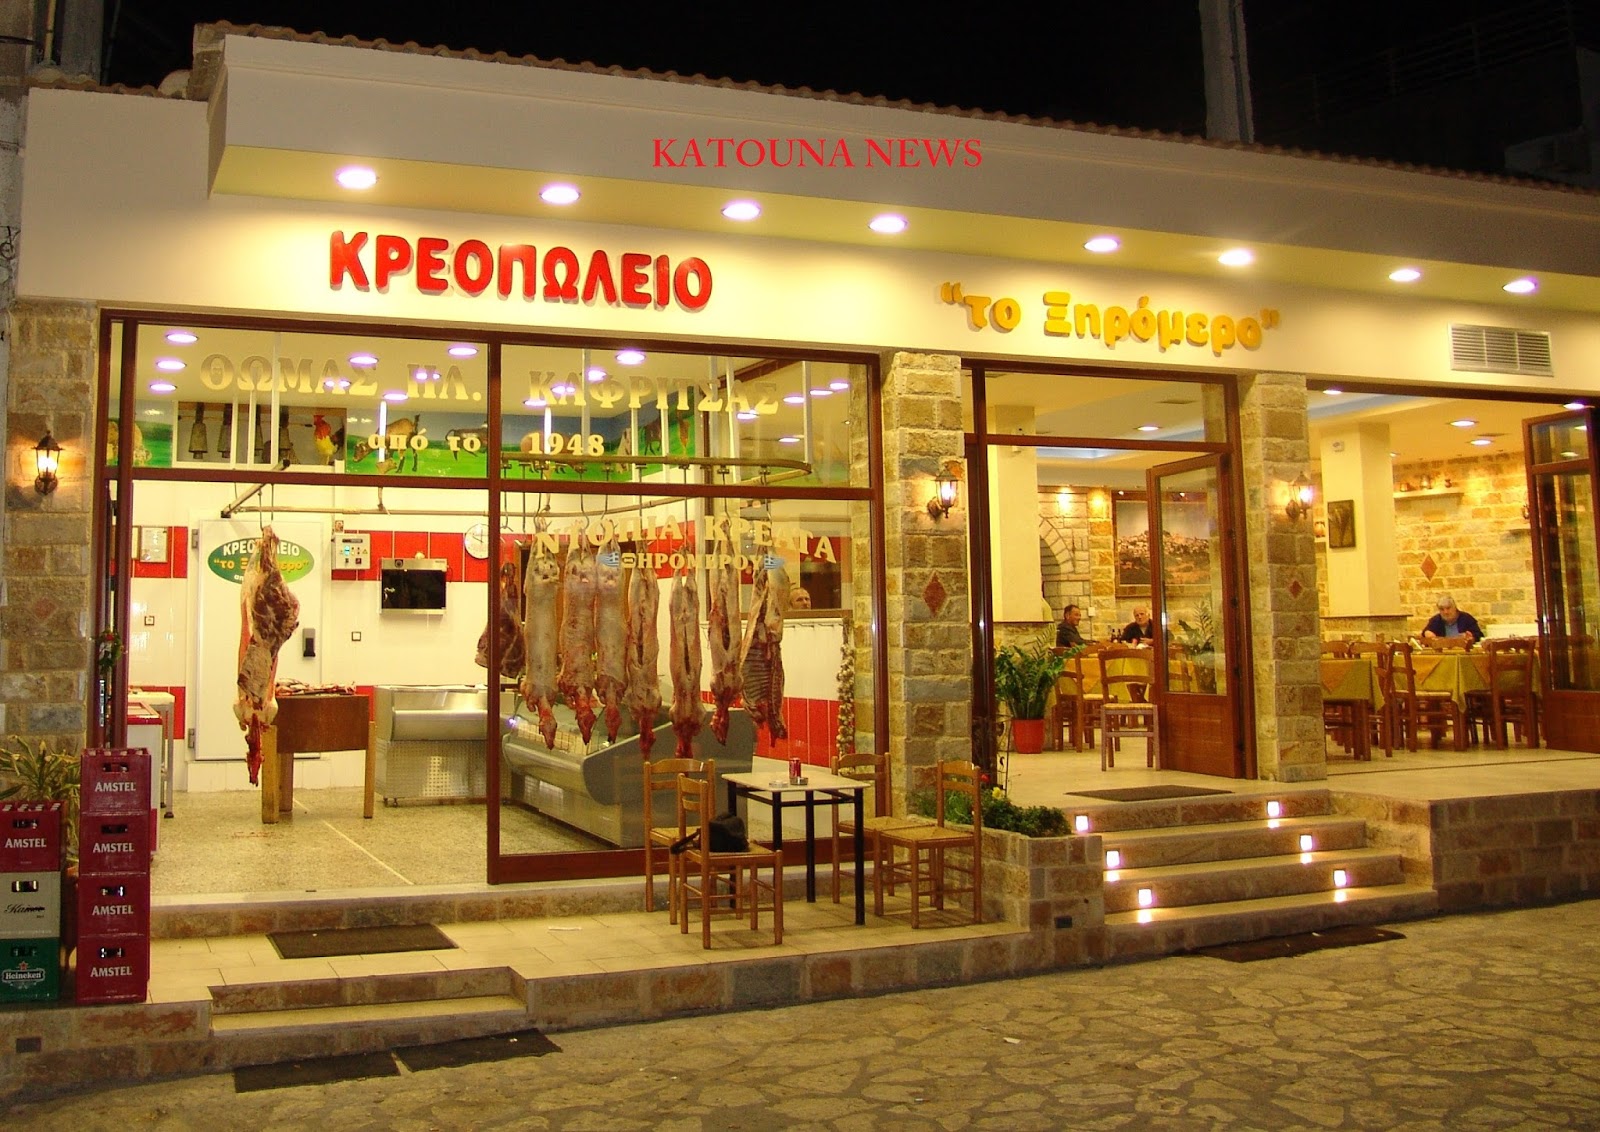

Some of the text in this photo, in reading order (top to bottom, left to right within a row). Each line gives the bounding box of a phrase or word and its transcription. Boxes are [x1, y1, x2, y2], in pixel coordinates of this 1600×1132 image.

[329, 230, 713, 311] ΚΡΕΟΠΩΛΕΙΟ
[200, 353, 378, 396] ΘΩΜΑΣ
[368, 427, 604, 456] από το 1948
[95, 782, 136, 792] AMSTEL
[4, 838, 47, 848] AMSTEL
[93, 843, 134, 853] AMSTEL
[92, 905, 134, 915] AMSTEL
[5, 972, 41, 980] Heineken
[90, 966, 132, 977] AMSTEL
